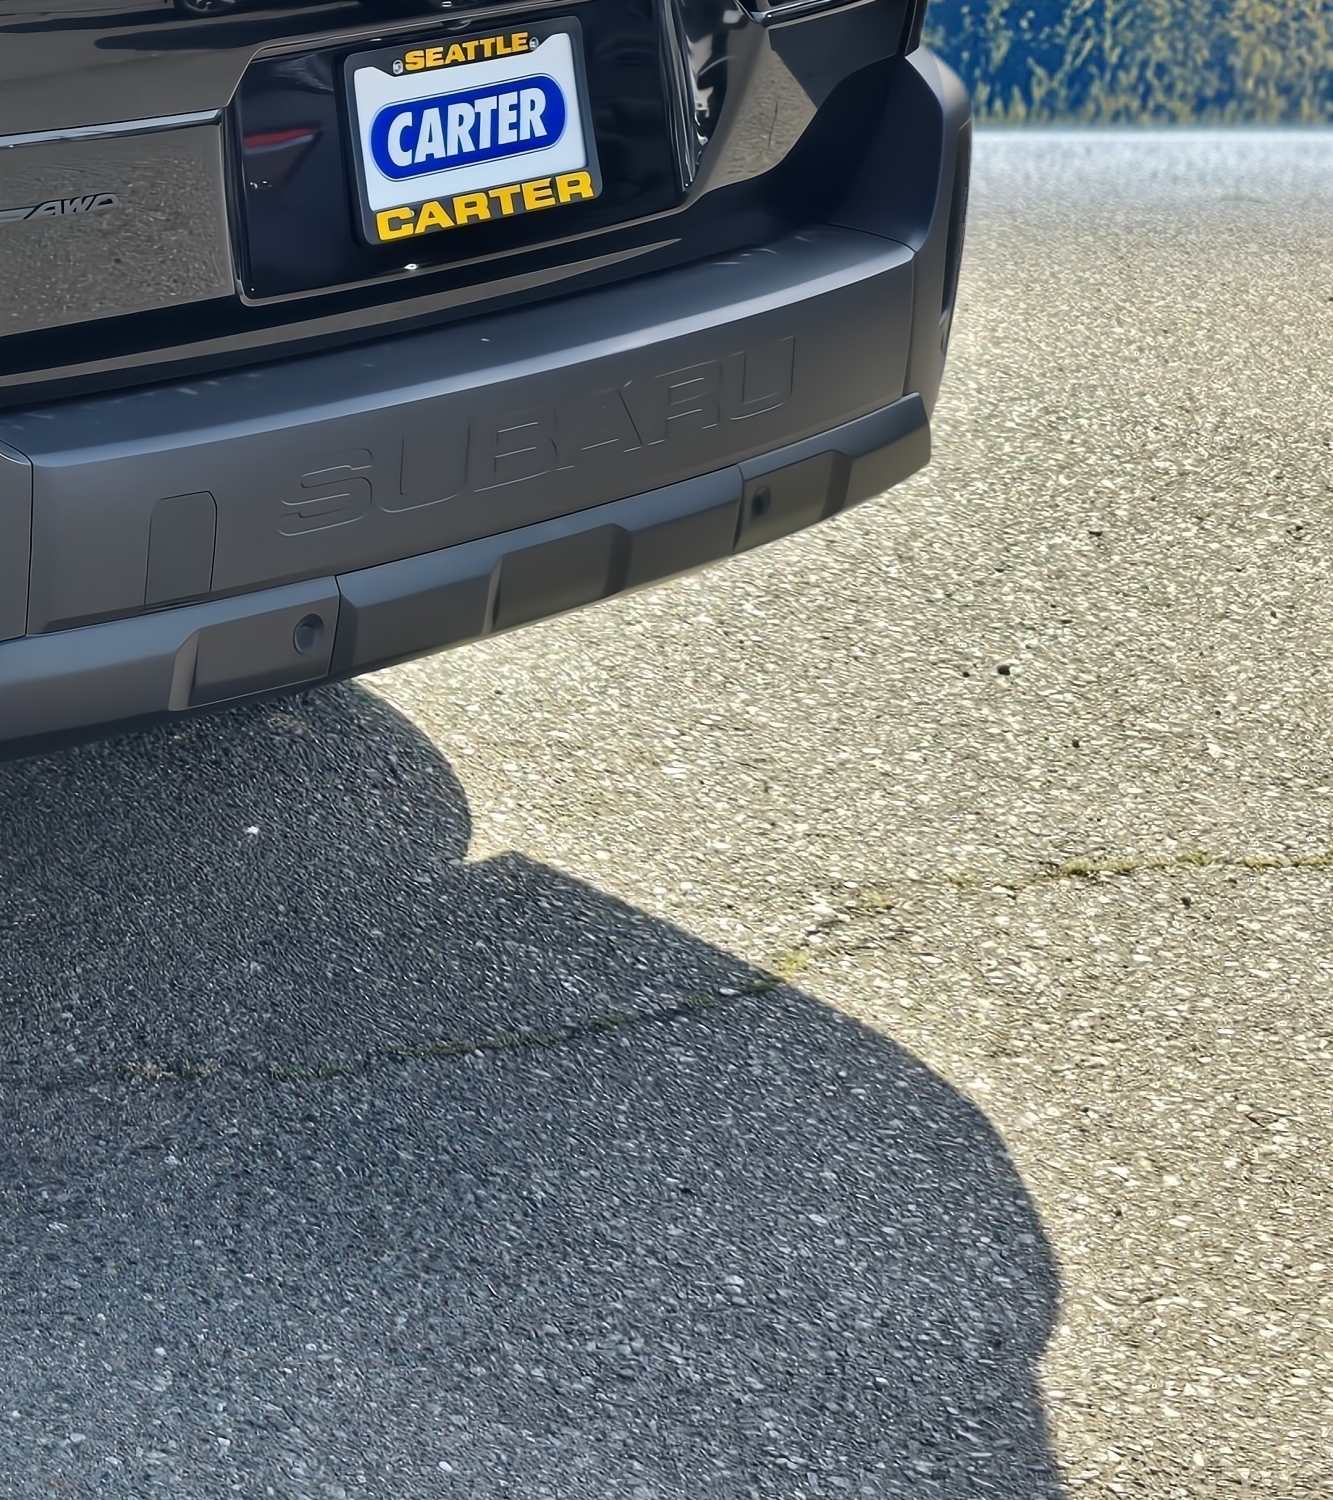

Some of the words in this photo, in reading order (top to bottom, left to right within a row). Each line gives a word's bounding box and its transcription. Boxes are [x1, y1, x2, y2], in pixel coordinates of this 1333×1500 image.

[403, 31, 530, 73] SEATTLE
[386, 86, 549, 167] CARTER
[23, 192, 119, 220] AWD
[375, 170, 595, 242] CARTER
[277, 335, 797, 536] SUBARU
